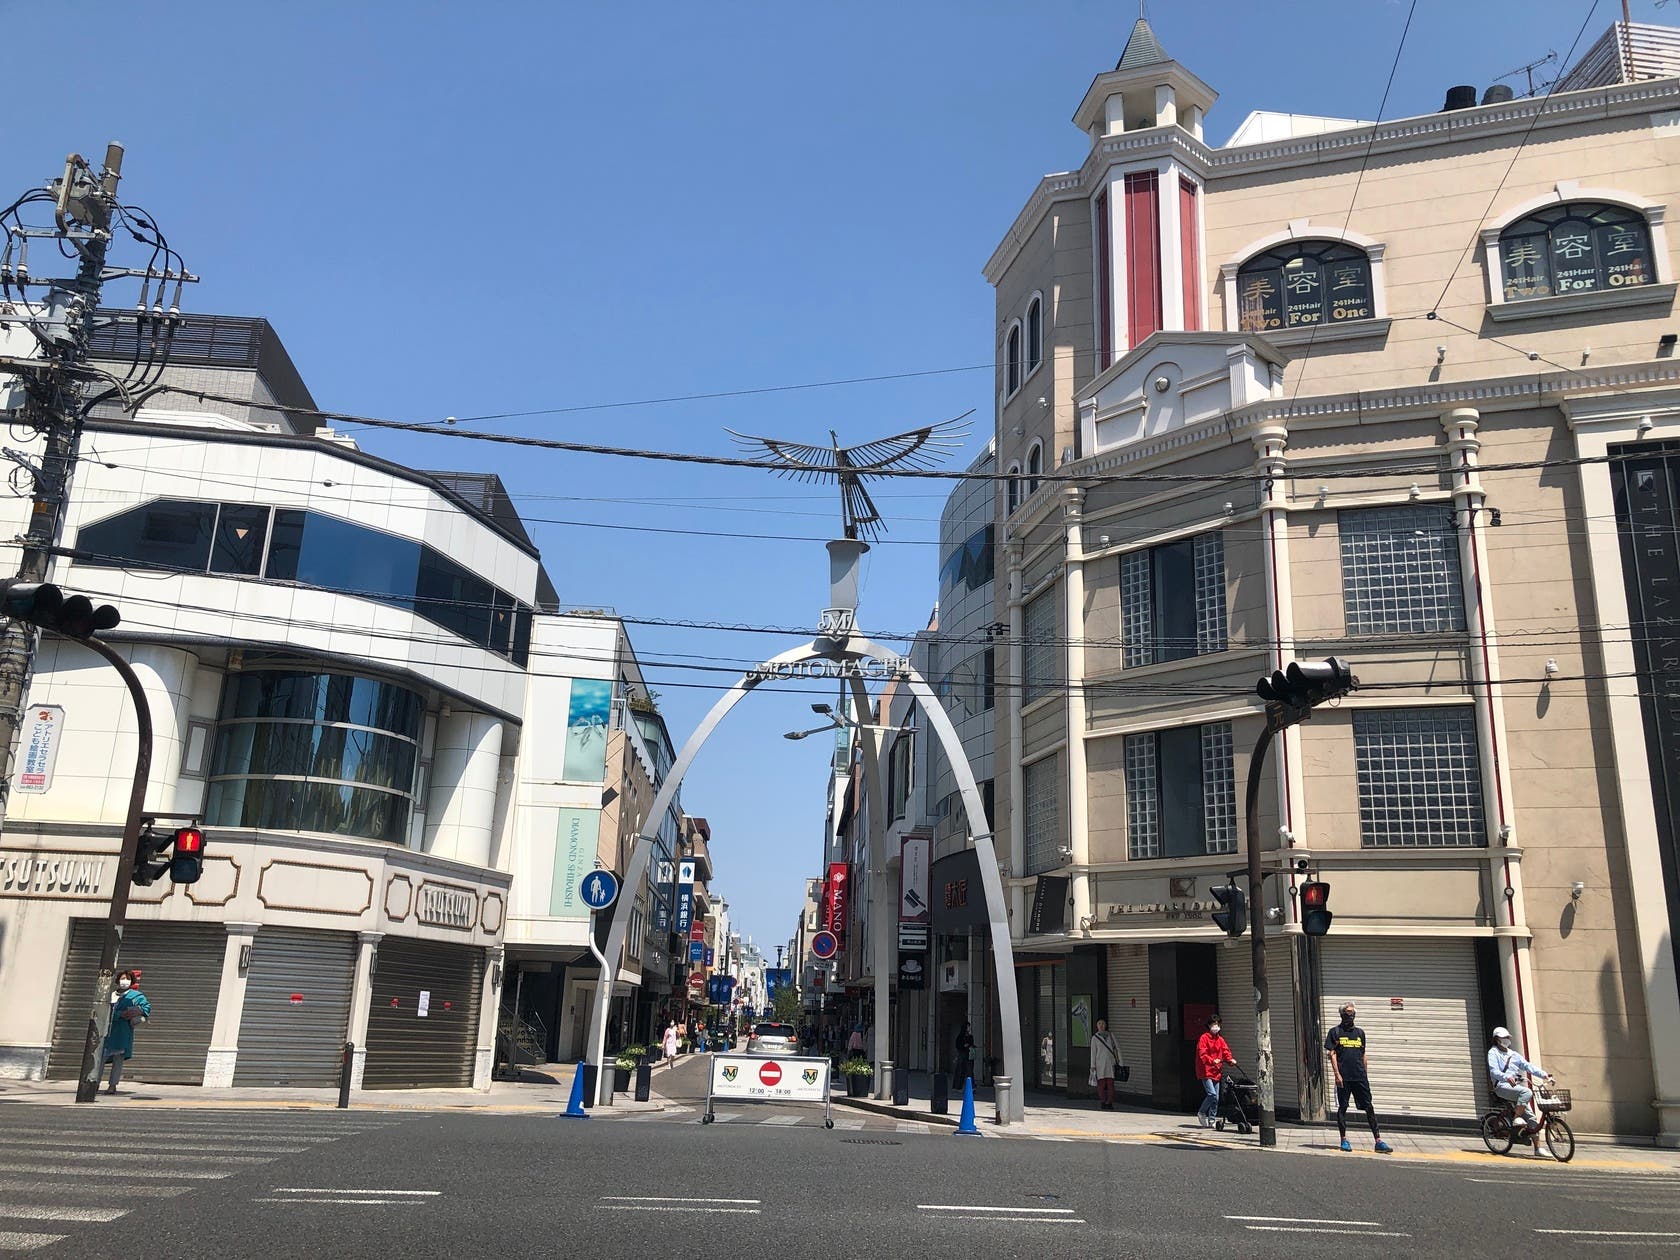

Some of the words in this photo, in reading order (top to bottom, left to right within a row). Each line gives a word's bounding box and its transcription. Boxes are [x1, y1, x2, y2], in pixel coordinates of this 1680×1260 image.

[1505, 231, 1644, 267] 美容室
[1243, 266, 1365, 299] 美容室
[1506, 275, 1545, 286] 241Hair
[1557, 268, 1596, 279] 241Hair
[1608, 263, 1648, 274] 241Hair
[1504, 284, 1549, 299] Two
[1559, 278, 1596, 292] For
[1608, 272, 1649, 286] One
[1288, 302, 1322, 312] 241Hair
[1289, 311, 1322, 325] For
[1332, 307, 1369, 320] One
[1332, 298, 1367, 307] 241Hair
[1642, 503, 1664, 557] THE
[1651, 577, 1680, 690] LAZARE
[745, 657, 911, 681] MOTOMACHI
[568, 817, 580, 862] DIAMOND
[564, 863, 576, 908] SHIRAISHI
[423, 888, 471, 919] TSUTSUMI
[680, 894, 689, 928] 横浜銀行
[833, 888, 843, 932] MANO
